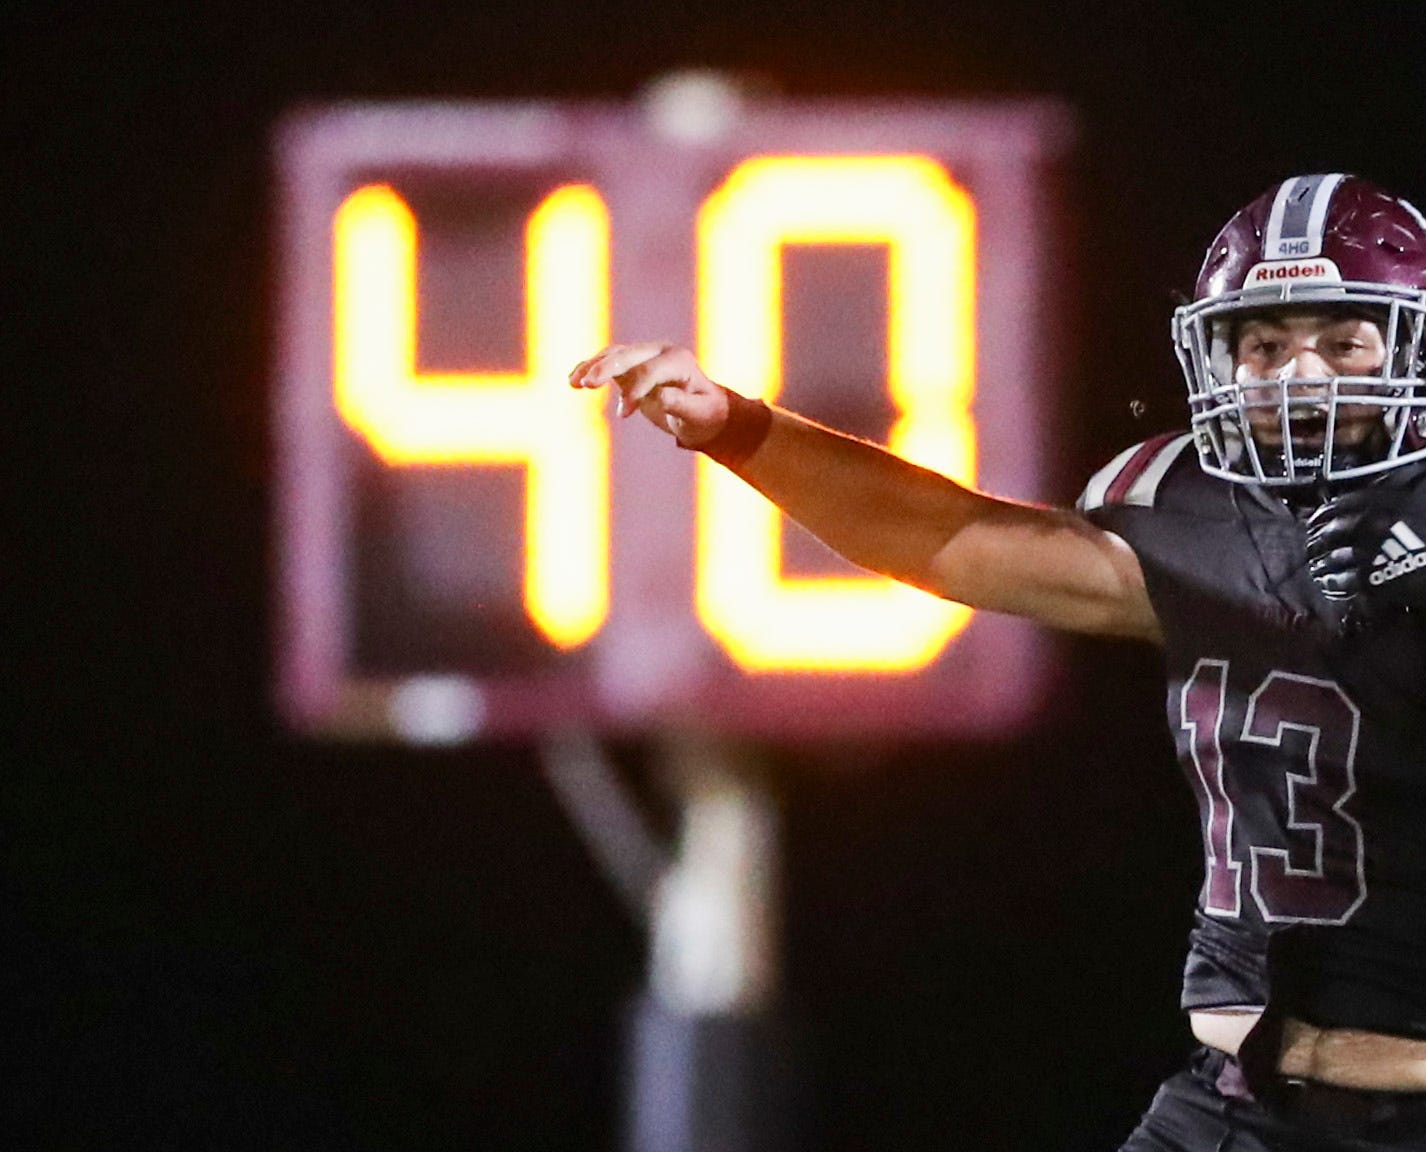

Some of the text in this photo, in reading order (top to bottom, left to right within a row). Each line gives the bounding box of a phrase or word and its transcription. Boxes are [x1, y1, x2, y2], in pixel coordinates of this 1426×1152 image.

[1256, 264, 1325, 280] Riddell
[1279, 241, 1310, 254] 4HG
[333, 152, 979, 675] 40
[1181, 658, 1367, 926] 13
